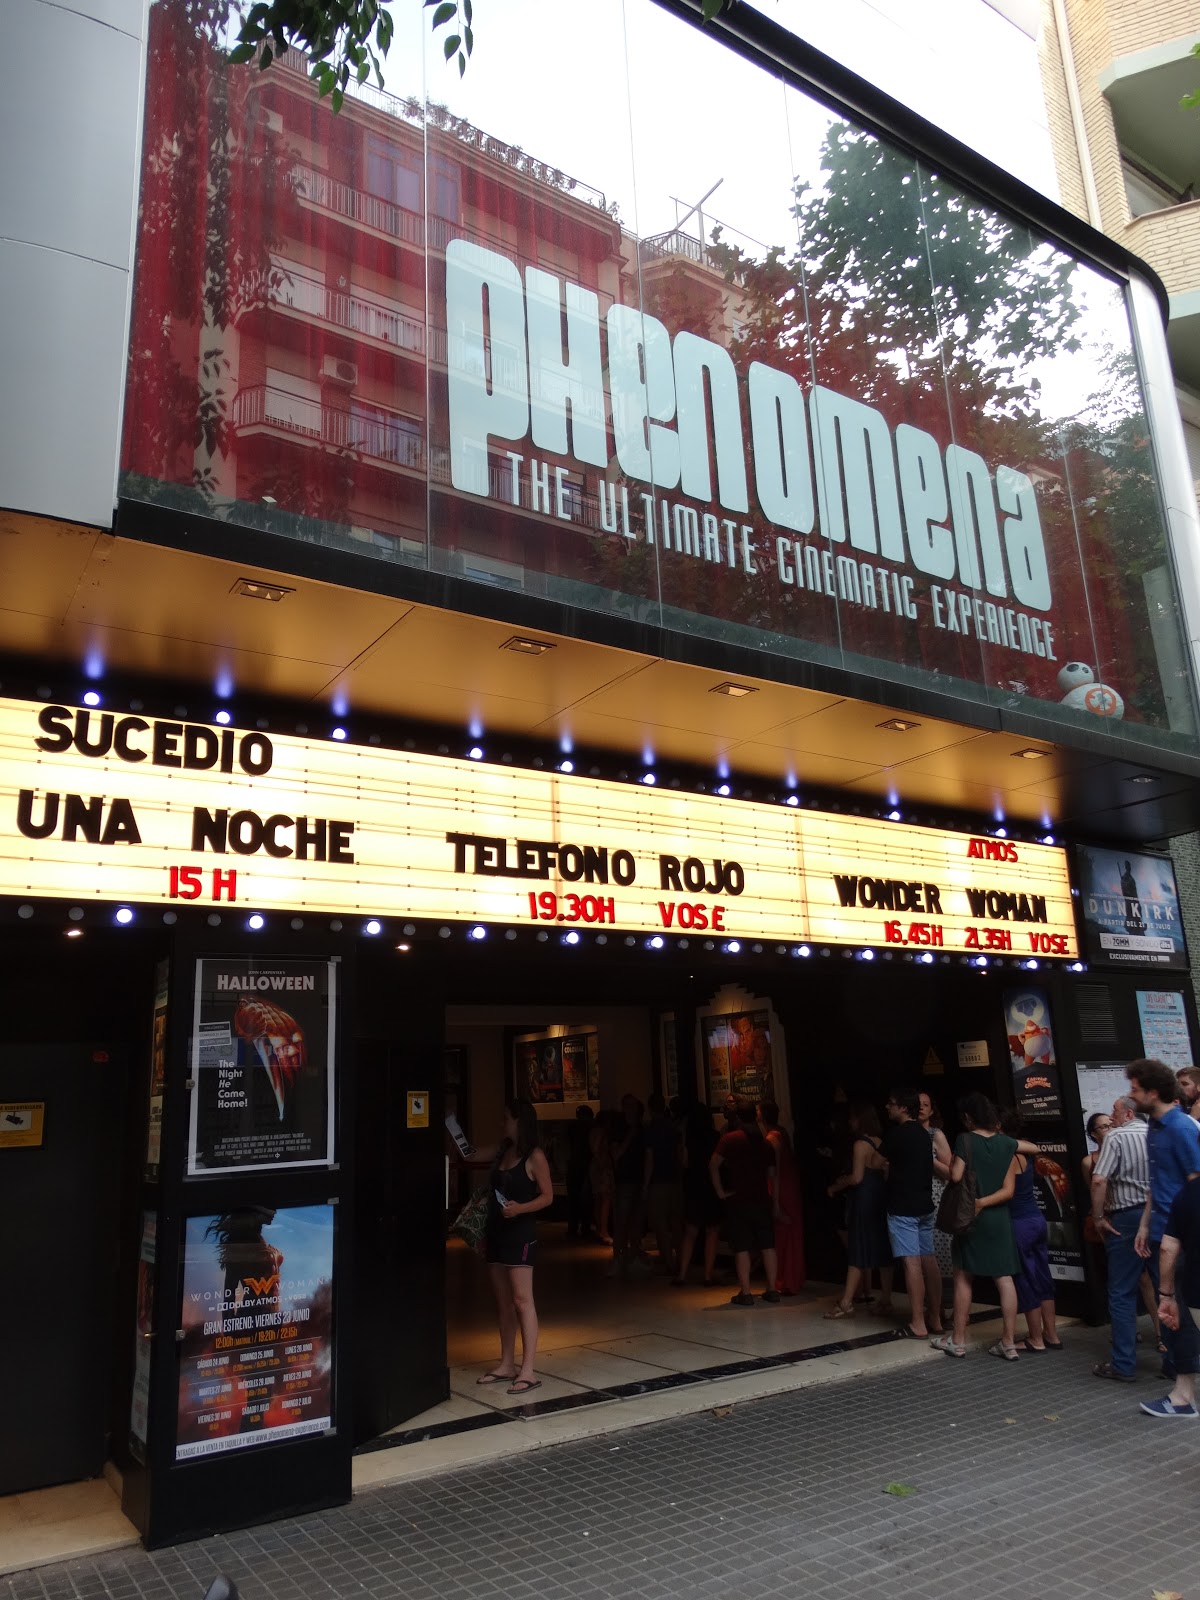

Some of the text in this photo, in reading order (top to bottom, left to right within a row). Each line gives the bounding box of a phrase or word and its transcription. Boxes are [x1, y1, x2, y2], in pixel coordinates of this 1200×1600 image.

[506, 451, 1057, 661] THE ULTIMATE CINEMATIC EXPERIENCE
[35, 706, 273, 776] SUCEDIO
[17, 789, 355, 863] UNA NOCHE
[966, 838, 1018, 862] ATMOS
[446, 832, 745, 896] TELEFONO ROJO
[170, 865, 237, 901] 15 H
[833, 875, 1047, 923] WONDER WOMAN
[1089, 898, 1175, 921] DUNKIRK
[528, 891, 726, 931] 19.30H VOSE
[884, 920, 943, 946] 16.45H
[1028, 932, 1070, 954] VOSE
[217, 974, 315, 991] HALLOWEEN
[218, 1070, 243, 1080] Night
[219, 1060, 235, 1069] The
[218, 1080, 232, 1088] He
[218, 1090, 245, 1098] Came
[218, 1099, 248, 1108] Home!
[1038, 1143, 1068, 1153] LOWEEN
[191, 1286, 250, 1302] WONDER
[229, 1299, 256, 1310] DOLBY
[256, 1296, 282, 1306] ATMOS
[203, 1321, 222, 1336] GRAN
[223, 1316, 254, 1332] ESTRENO:
[254, 1312, 282, 1328] VIERNES
[292, 1308, 310, 1323] JUNIO
